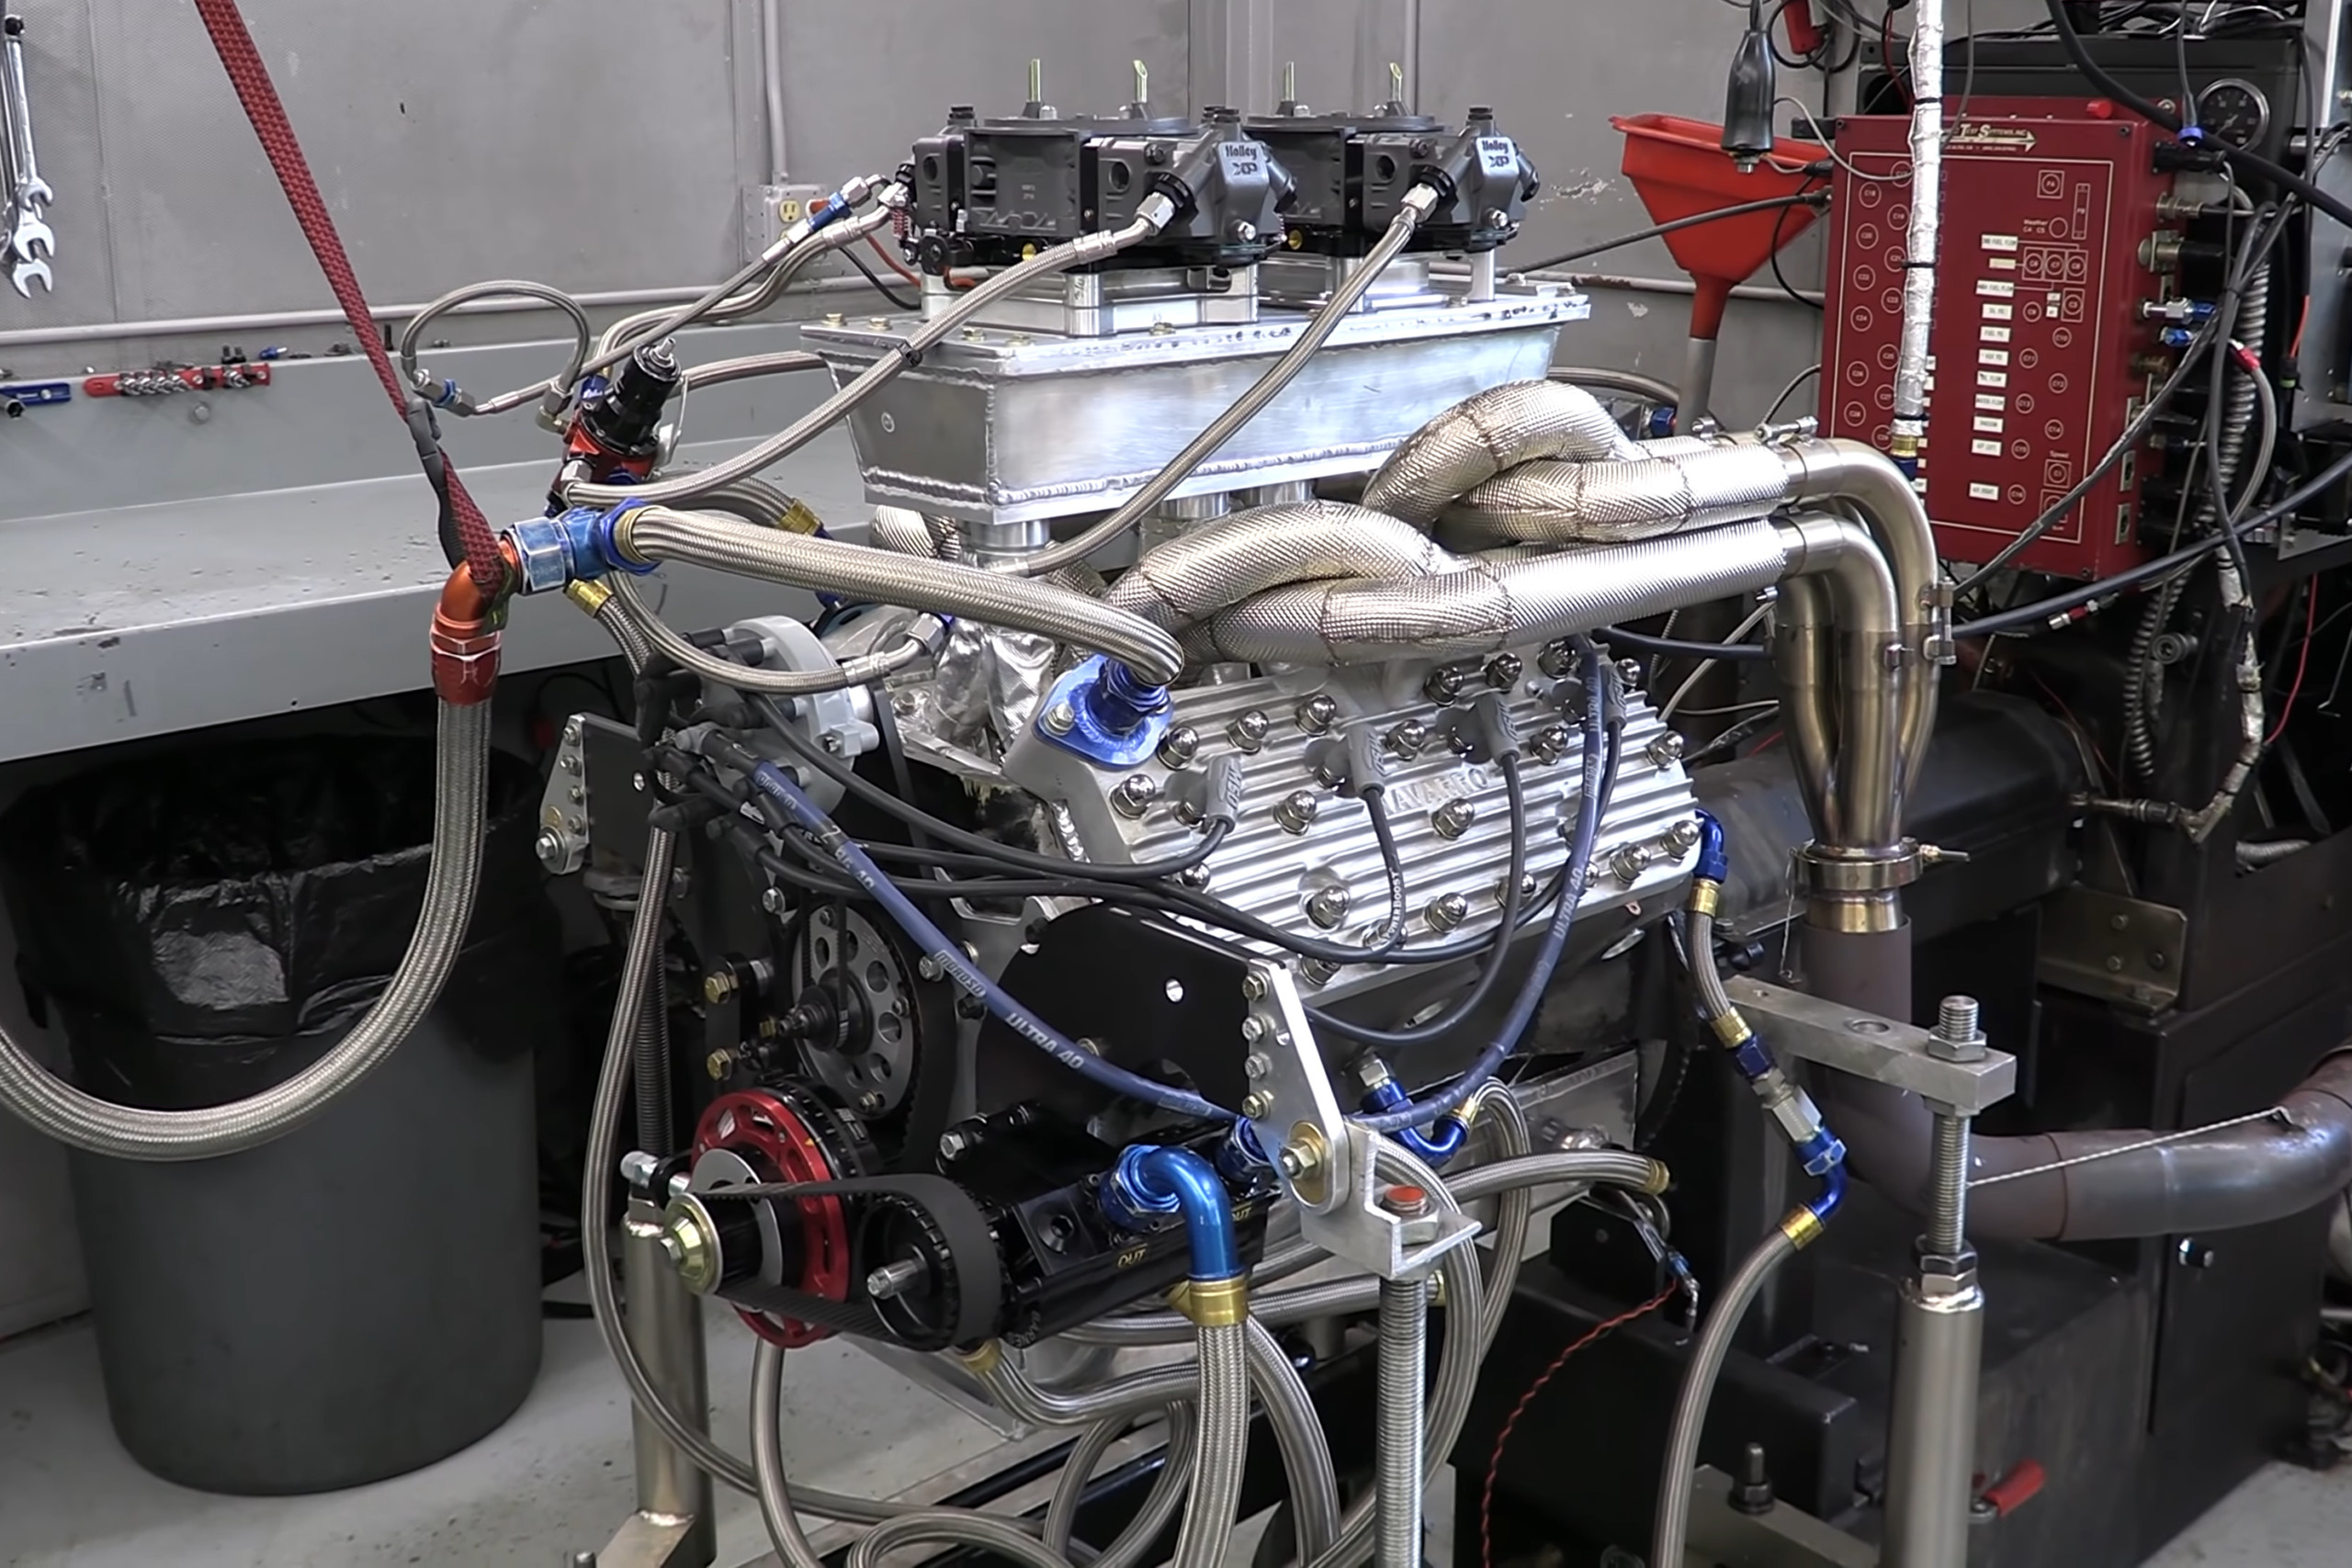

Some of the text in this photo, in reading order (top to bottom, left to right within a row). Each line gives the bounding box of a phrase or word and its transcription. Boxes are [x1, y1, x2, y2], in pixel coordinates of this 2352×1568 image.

[1225, 145, 1257, 160] Holley
[1483, 140, 1509, 154] Holley
[1226, 765, 1241, 810] MSD
[1382, 867, 1402, 940] POWERBOOST
[1553, 867, 1584, 940] ULTRA 40
[936, 951, 986, 995] MOROSO
[1005, 1012, 1084, 1069] ULTRA 40
[1117, 1248, 1146, 1269] OUT
